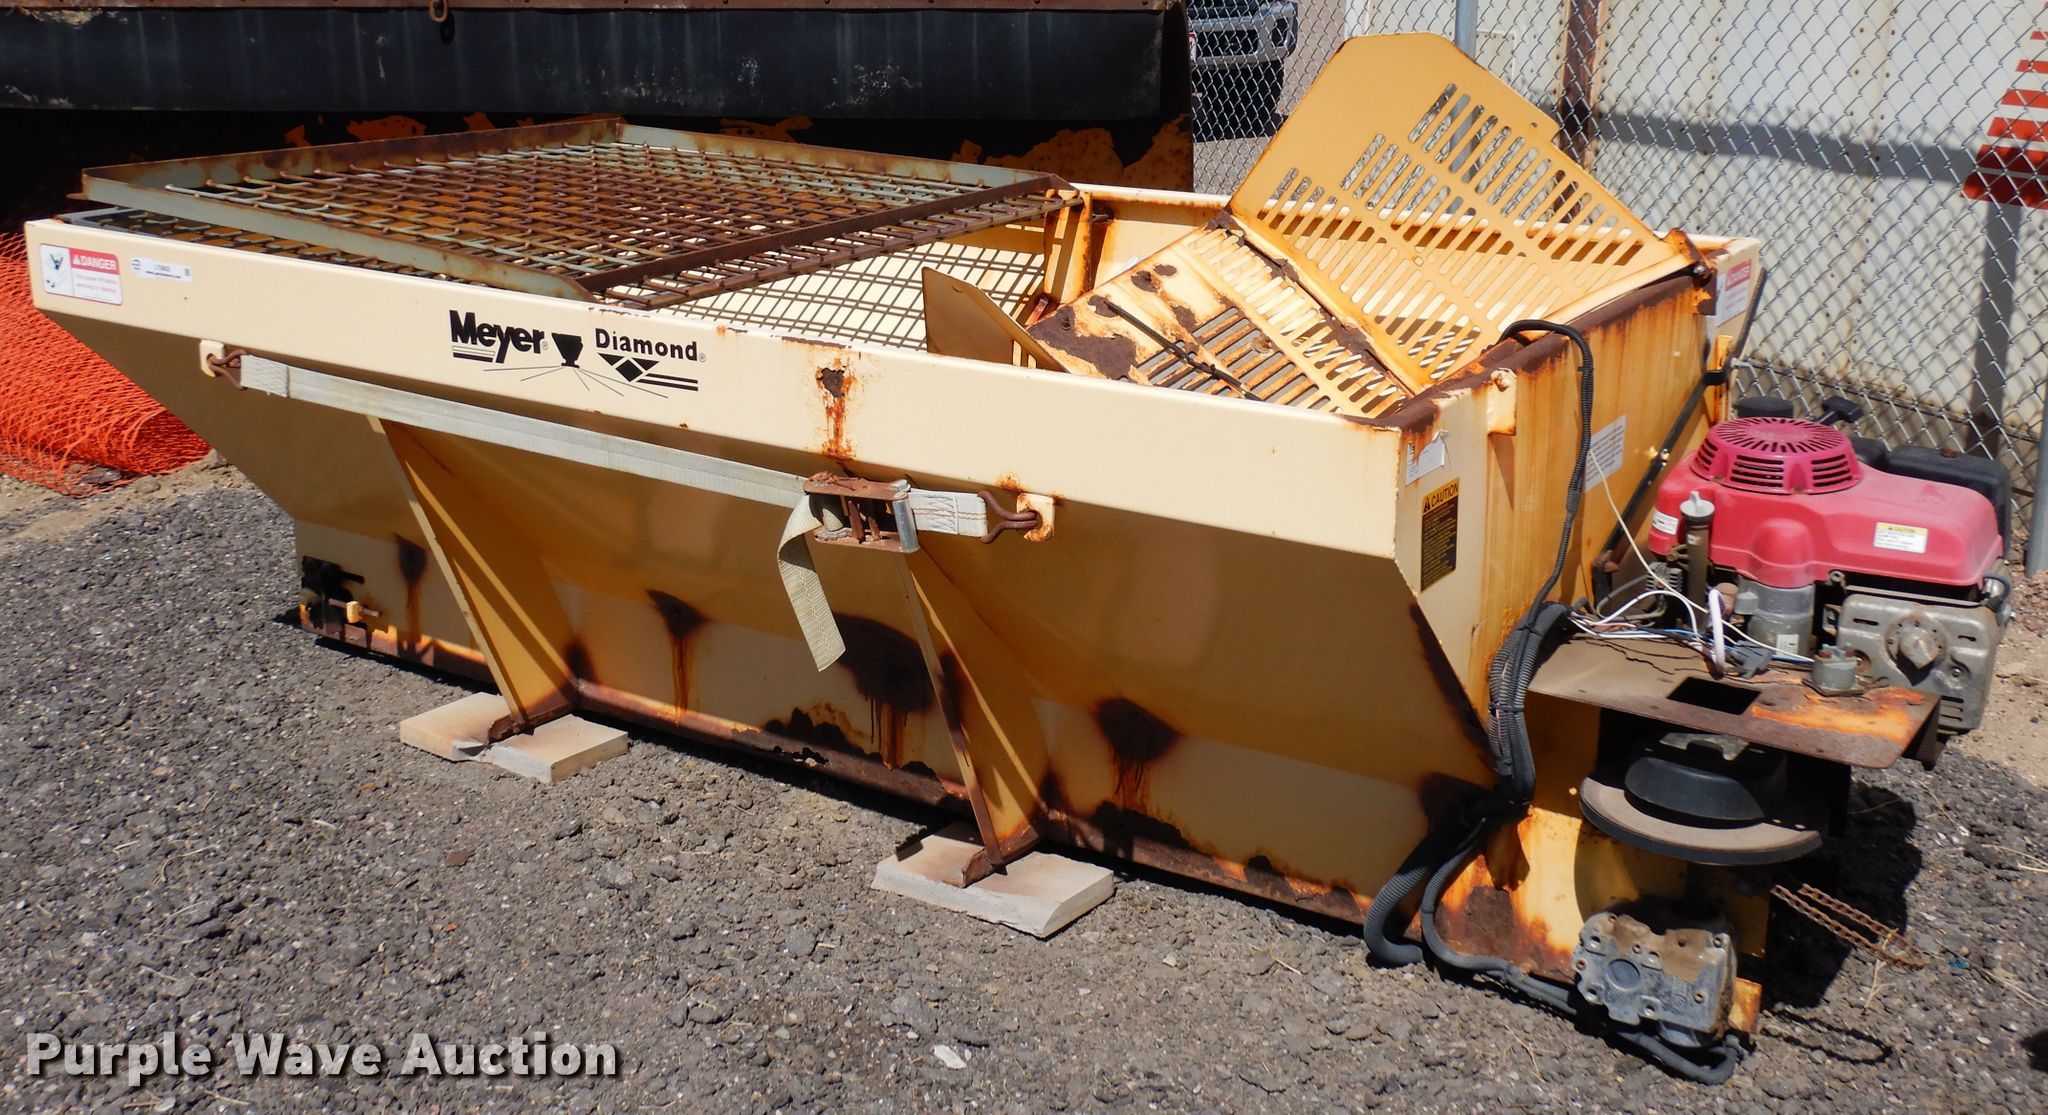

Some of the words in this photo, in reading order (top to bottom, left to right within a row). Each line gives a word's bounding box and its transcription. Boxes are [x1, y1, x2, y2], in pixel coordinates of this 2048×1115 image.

[80, 255, 117, 271] DANGER
[449, 310, 545, 364] Meyer
[595, 328, 698, 361] Diamond
[1431, 484, 1458, 507] CAUTION
